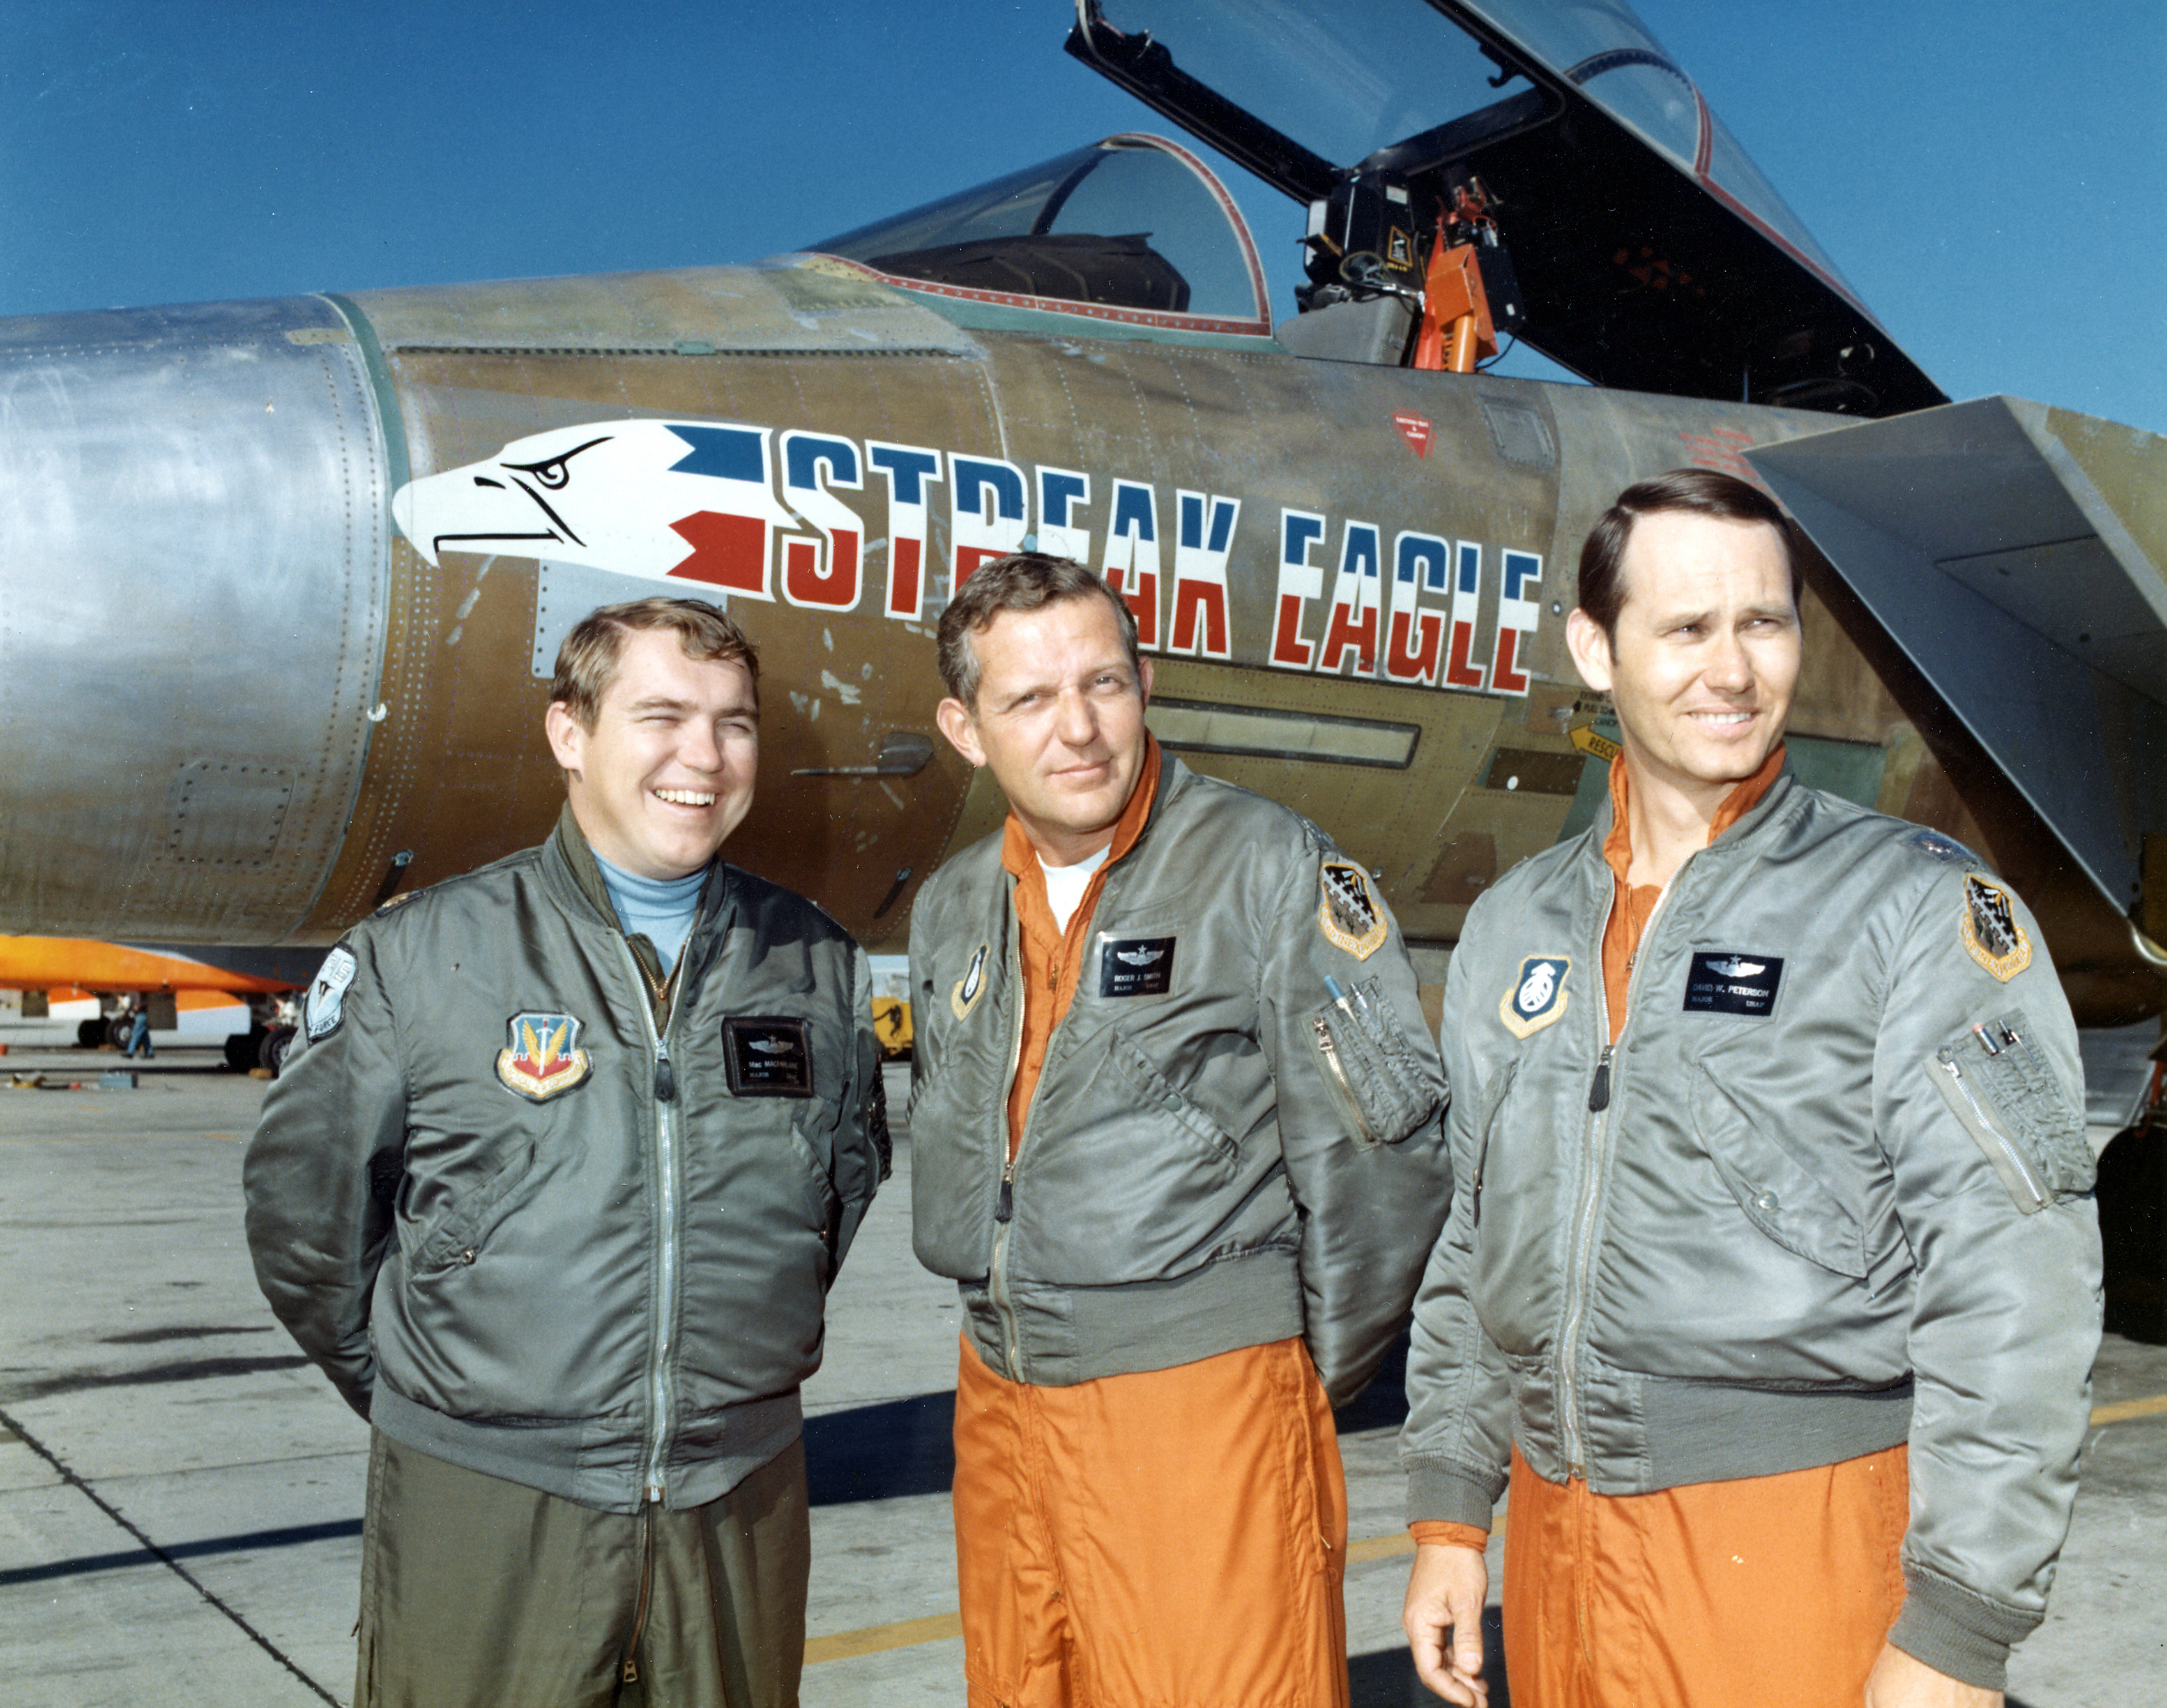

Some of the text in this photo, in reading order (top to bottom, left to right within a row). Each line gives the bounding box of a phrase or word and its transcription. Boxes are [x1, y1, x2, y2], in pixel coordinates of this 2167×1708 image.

[779, 430, 1542, 697] STREAK EAGLE
[1588, 736, 1619, 759] RESCU
[1114, 974, 1135, 982] ROGER
[1143, 972, 1161, 981] SMITH
[1693, 984, 1713, 992] DAVID
[1728, 984, 1770, 997] PETERSON
[315, 1015, 336, 1034] FORCE
